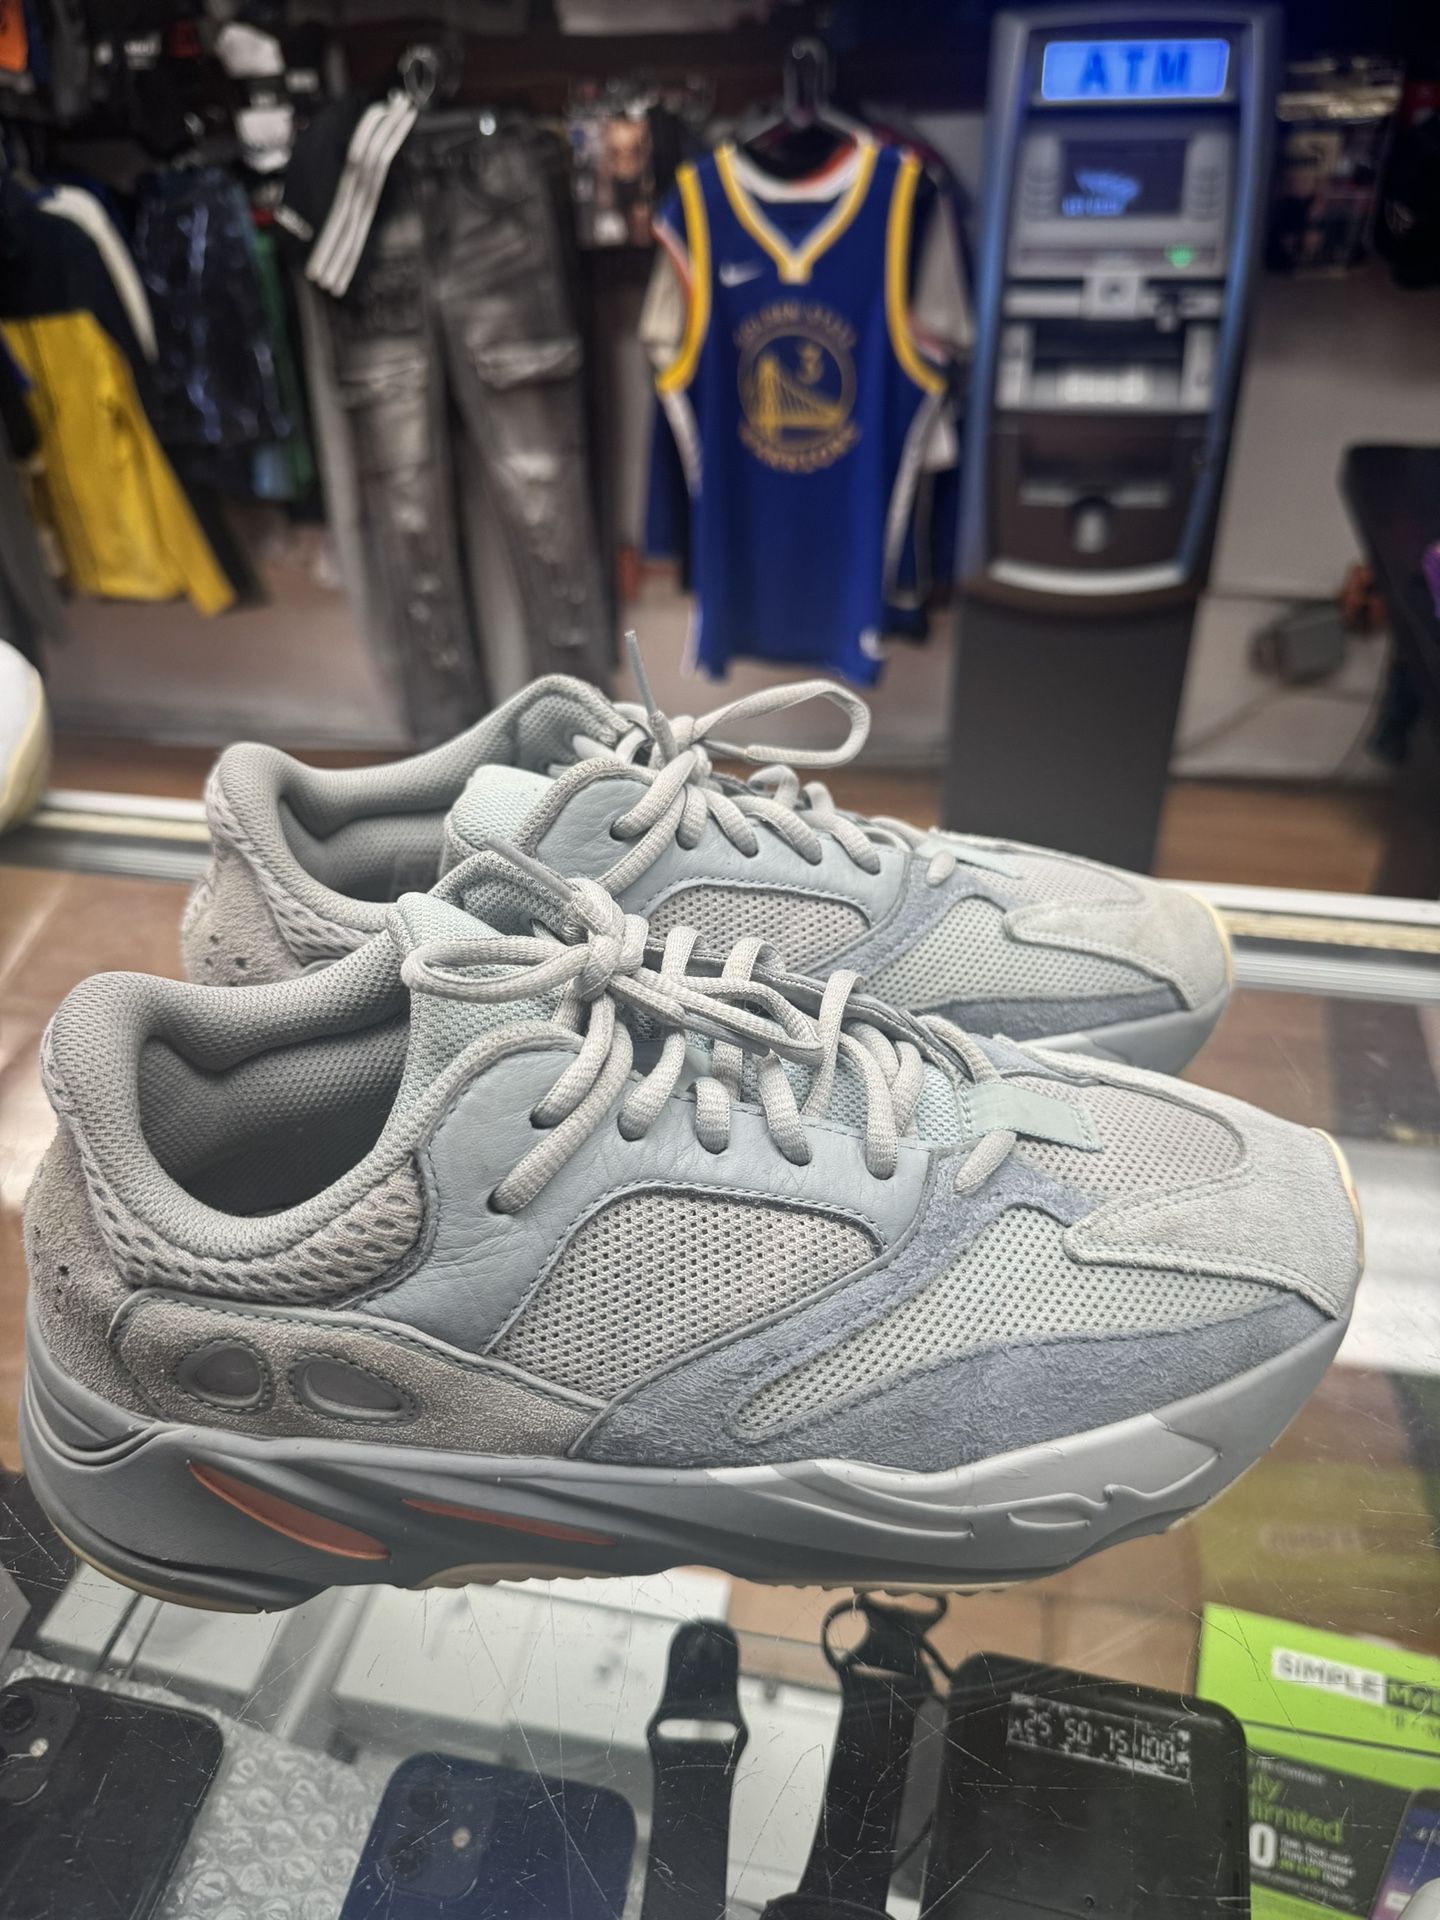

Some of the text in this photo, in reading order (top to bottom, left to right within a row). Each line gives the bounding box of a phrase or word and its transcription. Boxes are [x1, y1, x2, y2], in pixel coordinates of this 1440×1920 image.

[1078, 50, 1191, 95] ATM
[1277, 1651, 1380, 1701] SIMPLE
[1103, 1725, 1129, 1754] 75
